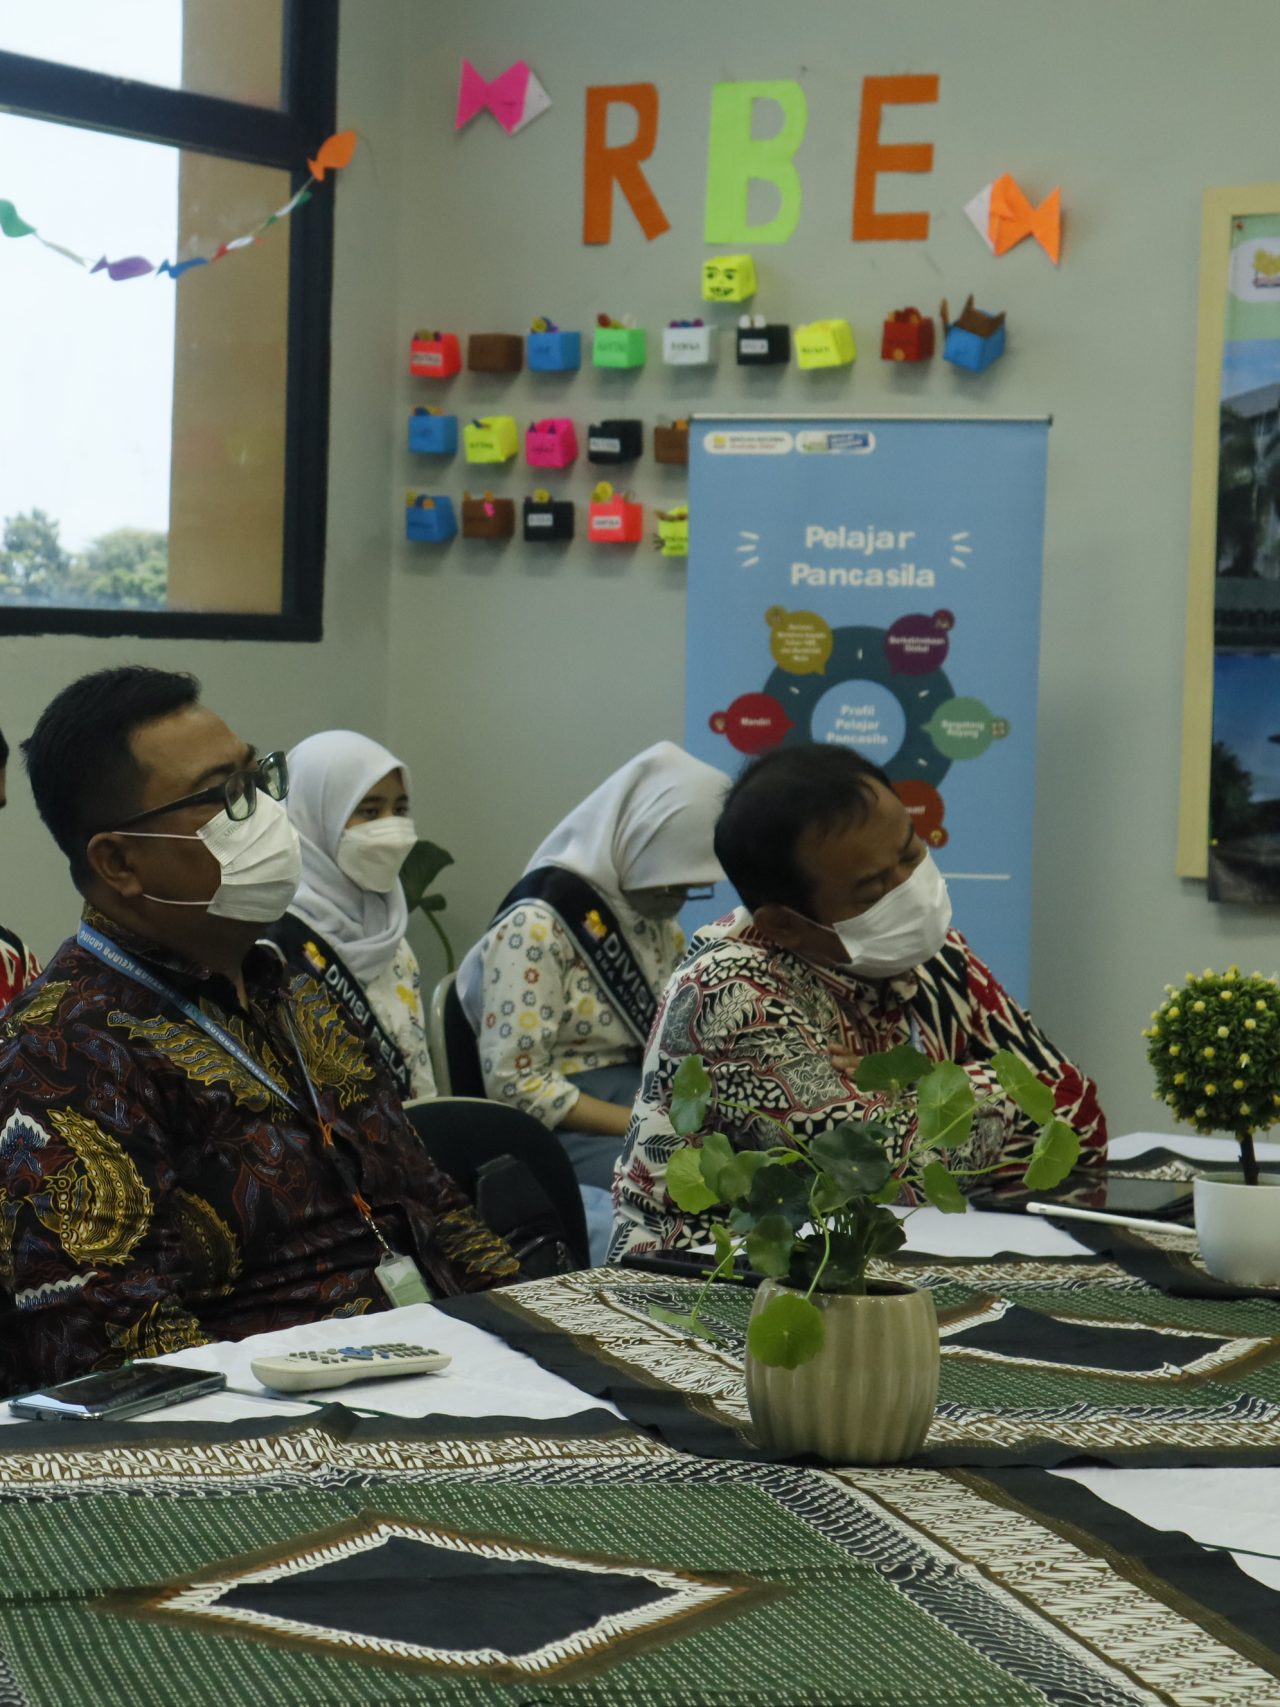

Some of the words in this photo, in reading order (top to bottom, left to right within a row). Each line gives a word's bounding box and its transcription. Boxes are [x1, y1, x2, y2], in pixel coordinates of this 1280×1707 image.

[806, 525, 916, 556] Pelajar
[790, 562, 936, 588] Pancasila
[841, 704, 875, 717] Profil
[826, 731, 888, 745] Pancasila
[835, 718, 879, 733] Pelajar
[79, 929, 104, 951] GADING
[101, 945, 135, 972] KELAPA
[599, 930, 654, 1017] DIVISI
[323, 962, 371, 1027] DIVISI
